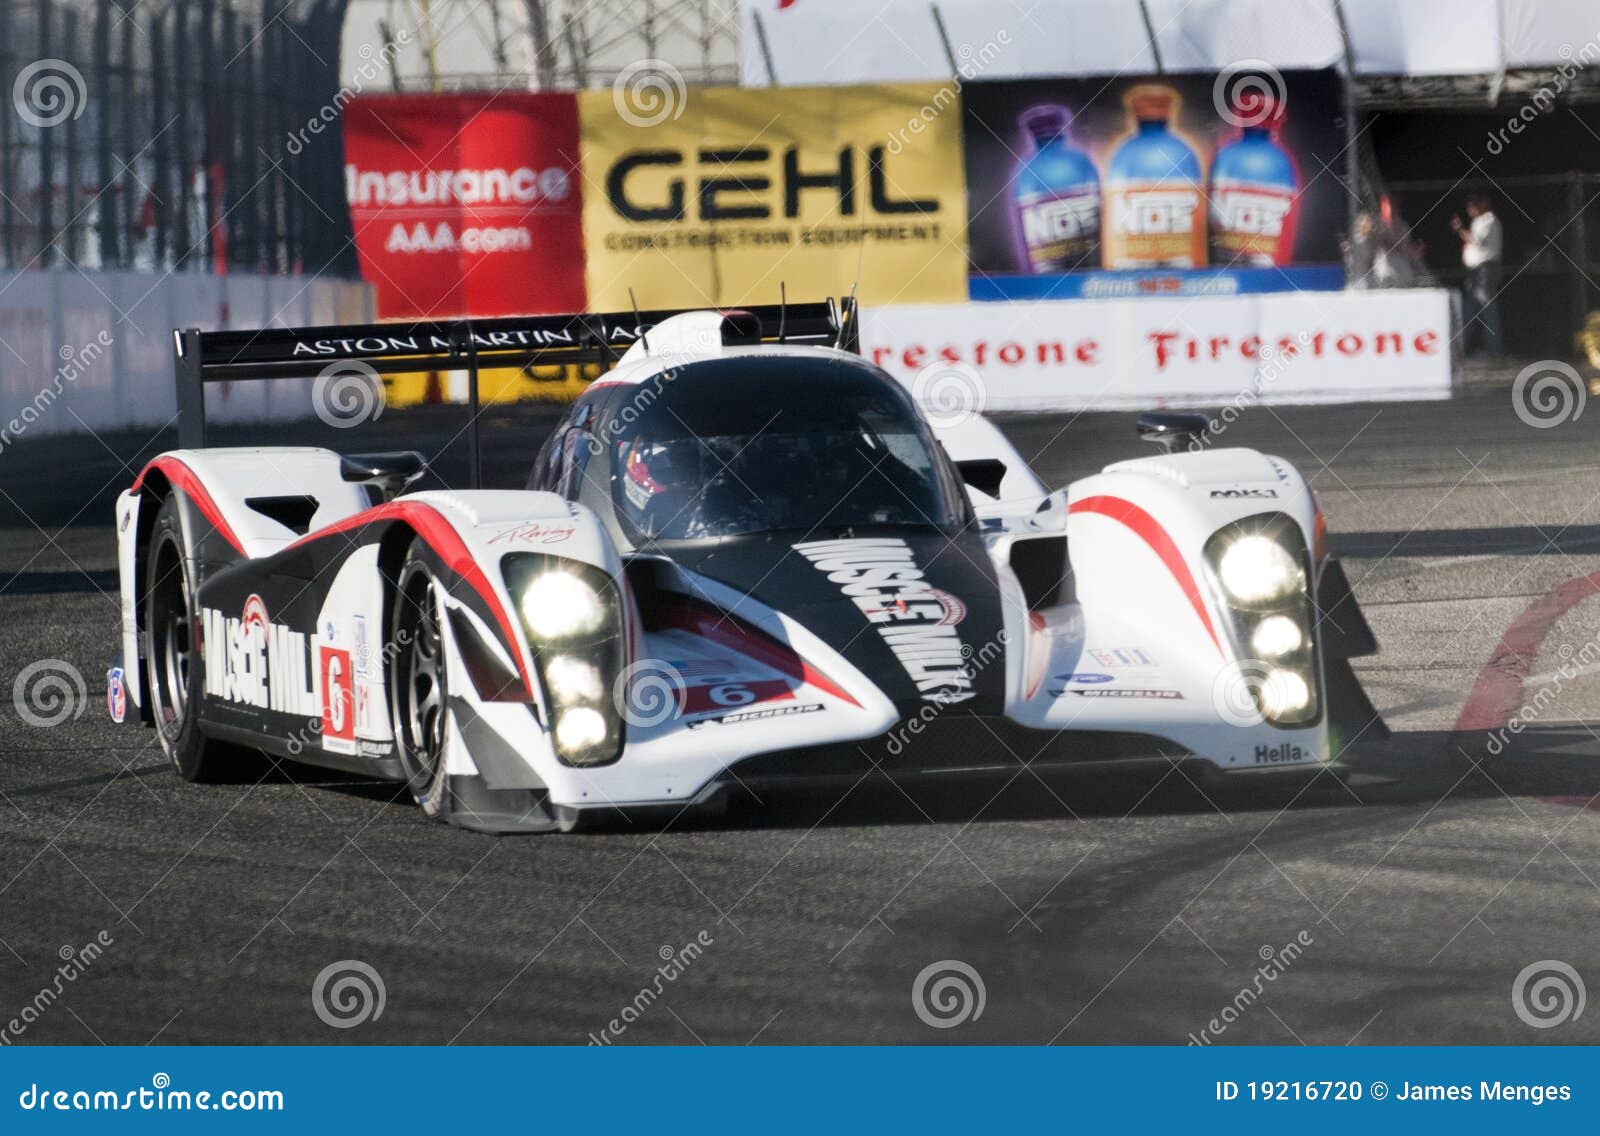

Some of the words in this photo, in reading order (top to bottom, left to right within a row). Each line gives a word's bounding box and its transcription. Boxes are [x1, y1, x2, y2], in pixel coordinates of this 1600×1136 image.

[345, 163, 571, 206] Insurance
[606, 143, 941, 222] GEHL
[1022, 195, 1101, 246] NOS
[1111, 193, 1200, 234] NOS
[1210, 198, 1291, 236] NOS
[385, 222, 532, 254] AAA.com
[292, 335, 417, 356] ASTON
[1147, 328, 1440, 373] Firestone
[329, 655, 345, 733] 6
[709, 684, 756, 706] 6
[1255, 743, 1302, 764] Hella
